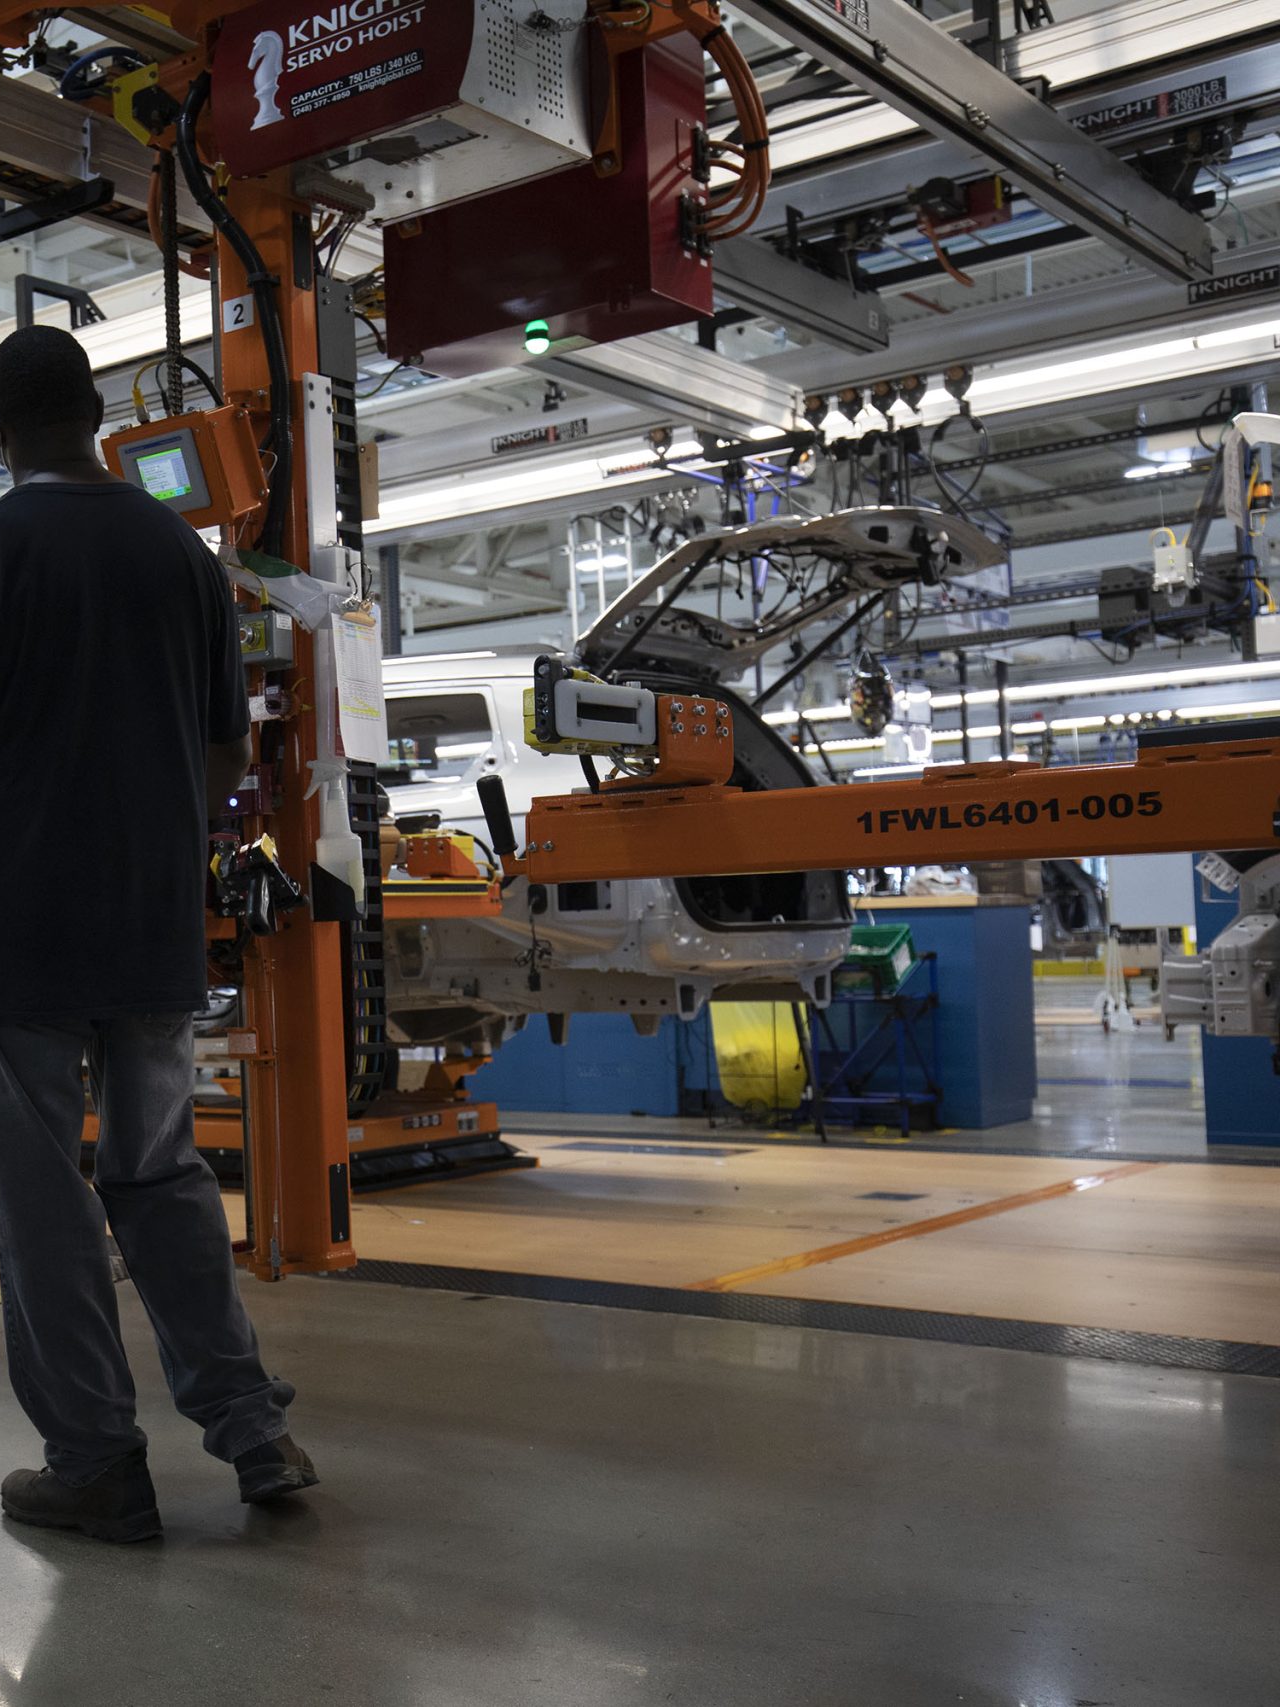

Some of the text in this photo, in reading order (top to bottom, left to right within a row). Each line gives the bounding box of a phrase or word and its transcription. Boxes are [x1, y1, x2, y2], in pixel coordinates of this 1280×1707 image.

[287, 6, 426, 73] SERVO HOIST
[291, 80, 344, 105] CAPACITY:
[348, 75, 363, 86] 750
[364, 65, 382, 79] LBS
[388, 58, 403, 71] 340
[404, 52, 418, 64] KG
[292, 105, 312, 117] (248)
[358, 63, 422, 92] knightglobal.com
[1174, 86, 1201, 100] 3000
[1072, 97, 1157, 129] KNIGHT
[1174, 98, 1200, 113] 1361
[1199, 267, 1278, 294] KNIGHT
[233, 303, 244, 325] 2
[499, 428, 546, 446] KNIGHT
[856, 791, 1163, 834] 1FWL6401-005
